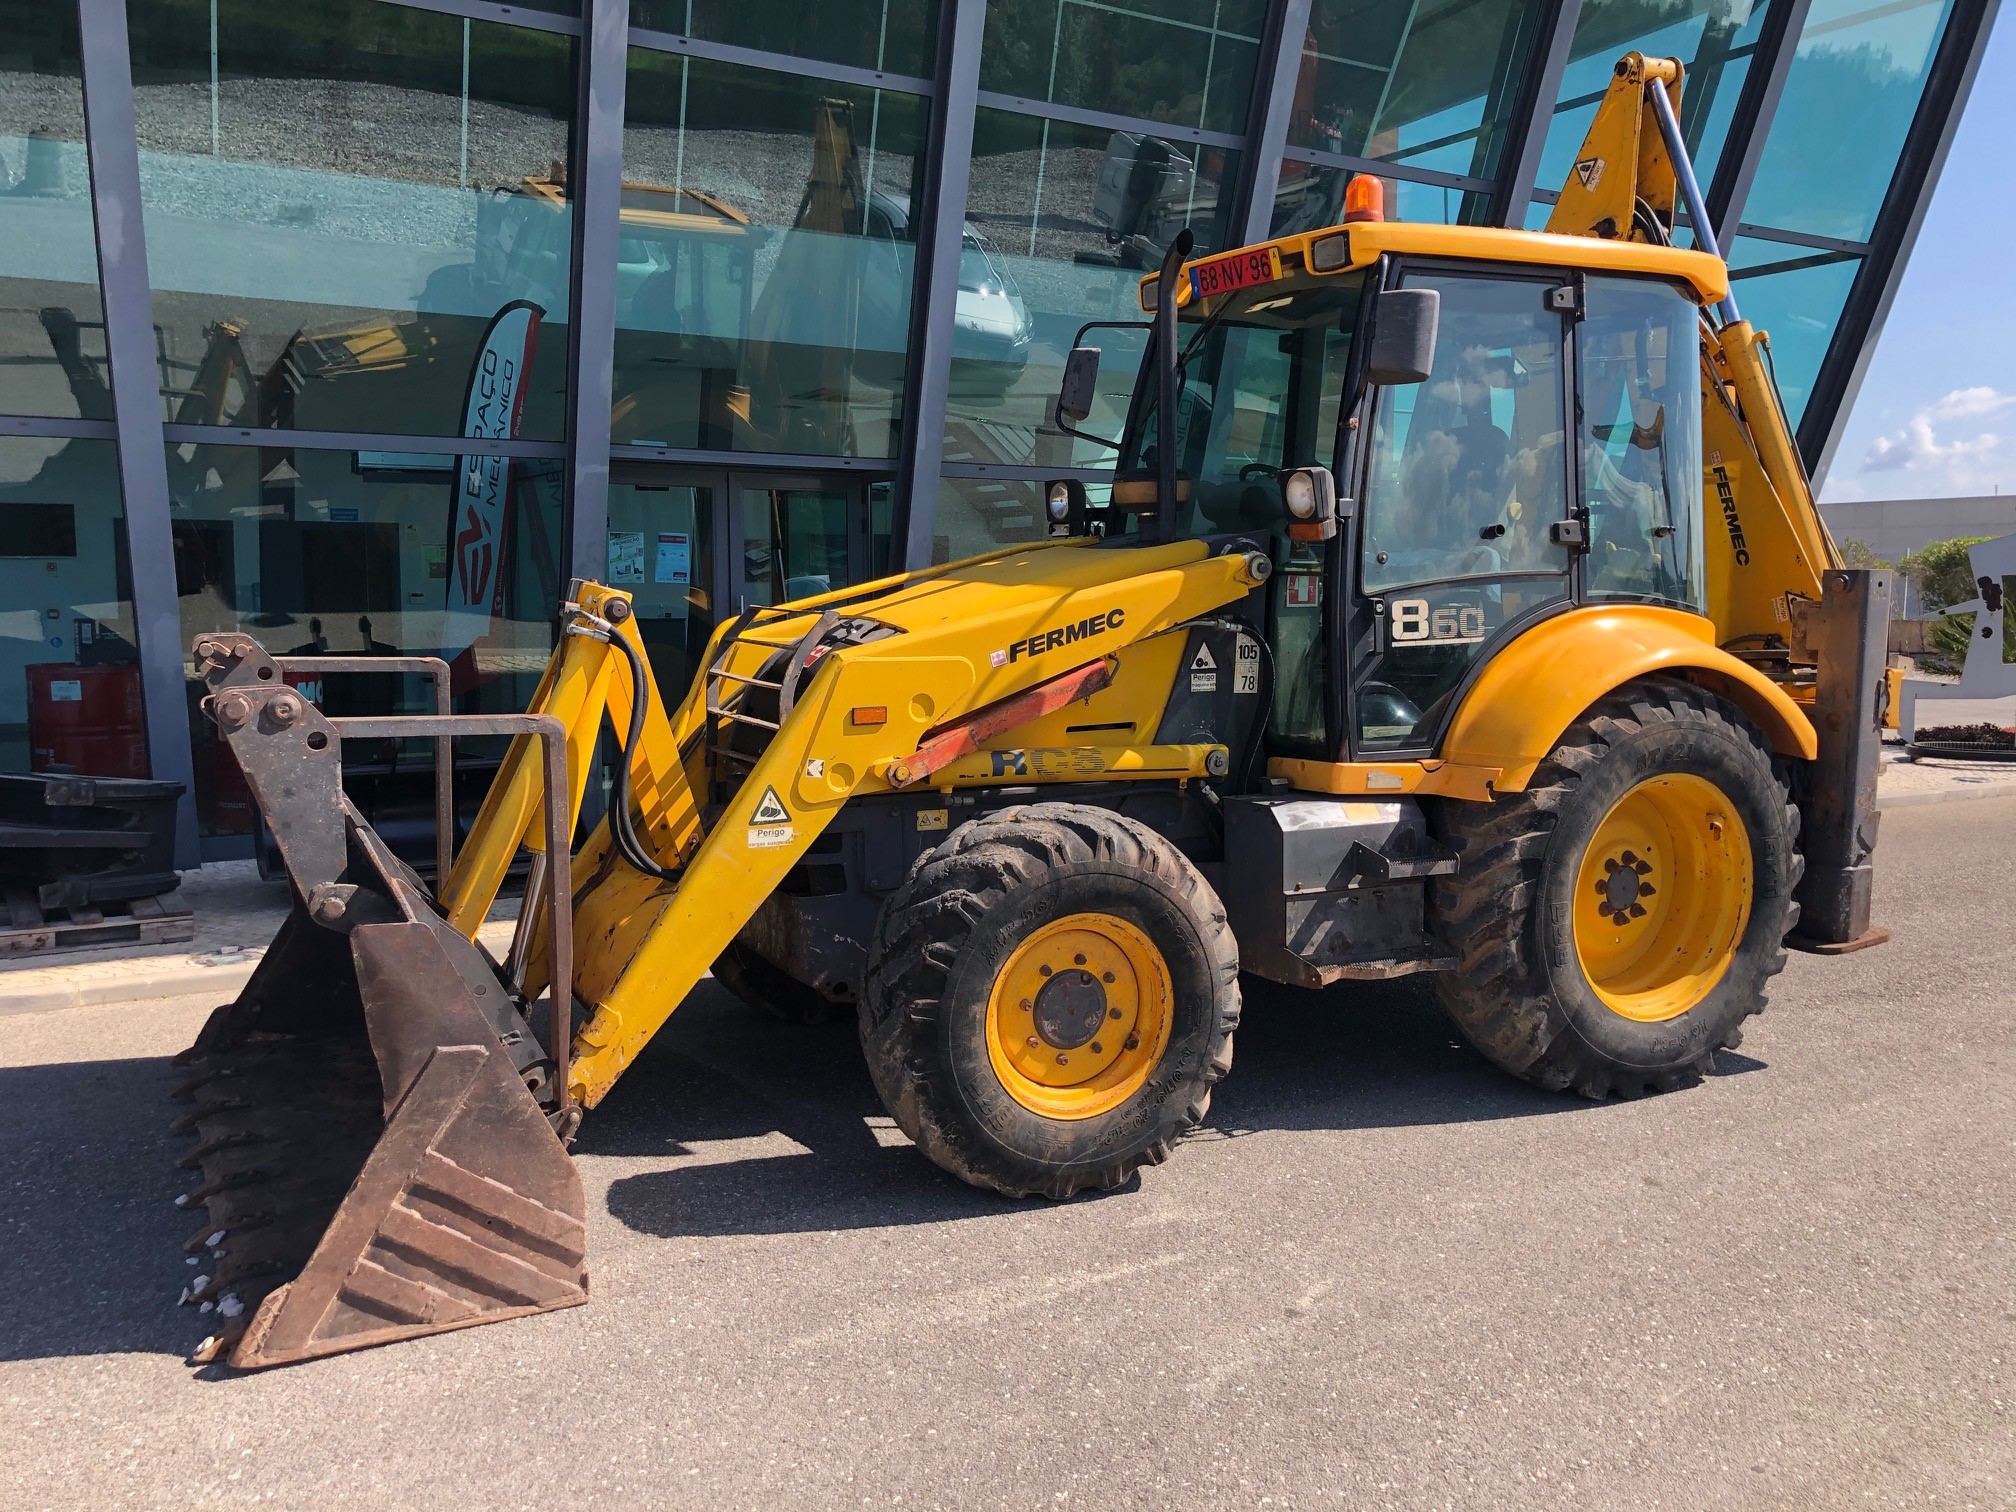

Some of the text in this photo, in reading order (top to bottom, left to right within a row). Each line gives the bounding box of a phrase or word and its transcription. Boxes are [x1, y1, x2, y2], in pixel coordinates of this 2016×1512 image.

[1713, 466, 1750, 566] FERMEC
[1391, 599, 1485, 641] 860
[1010, 608, 1125, 664] FERMEC
[1238, 644, 1258, 660] 105
[1241, 675, 1255, 691] 78
[757, 829, 785, 838] Perigo
